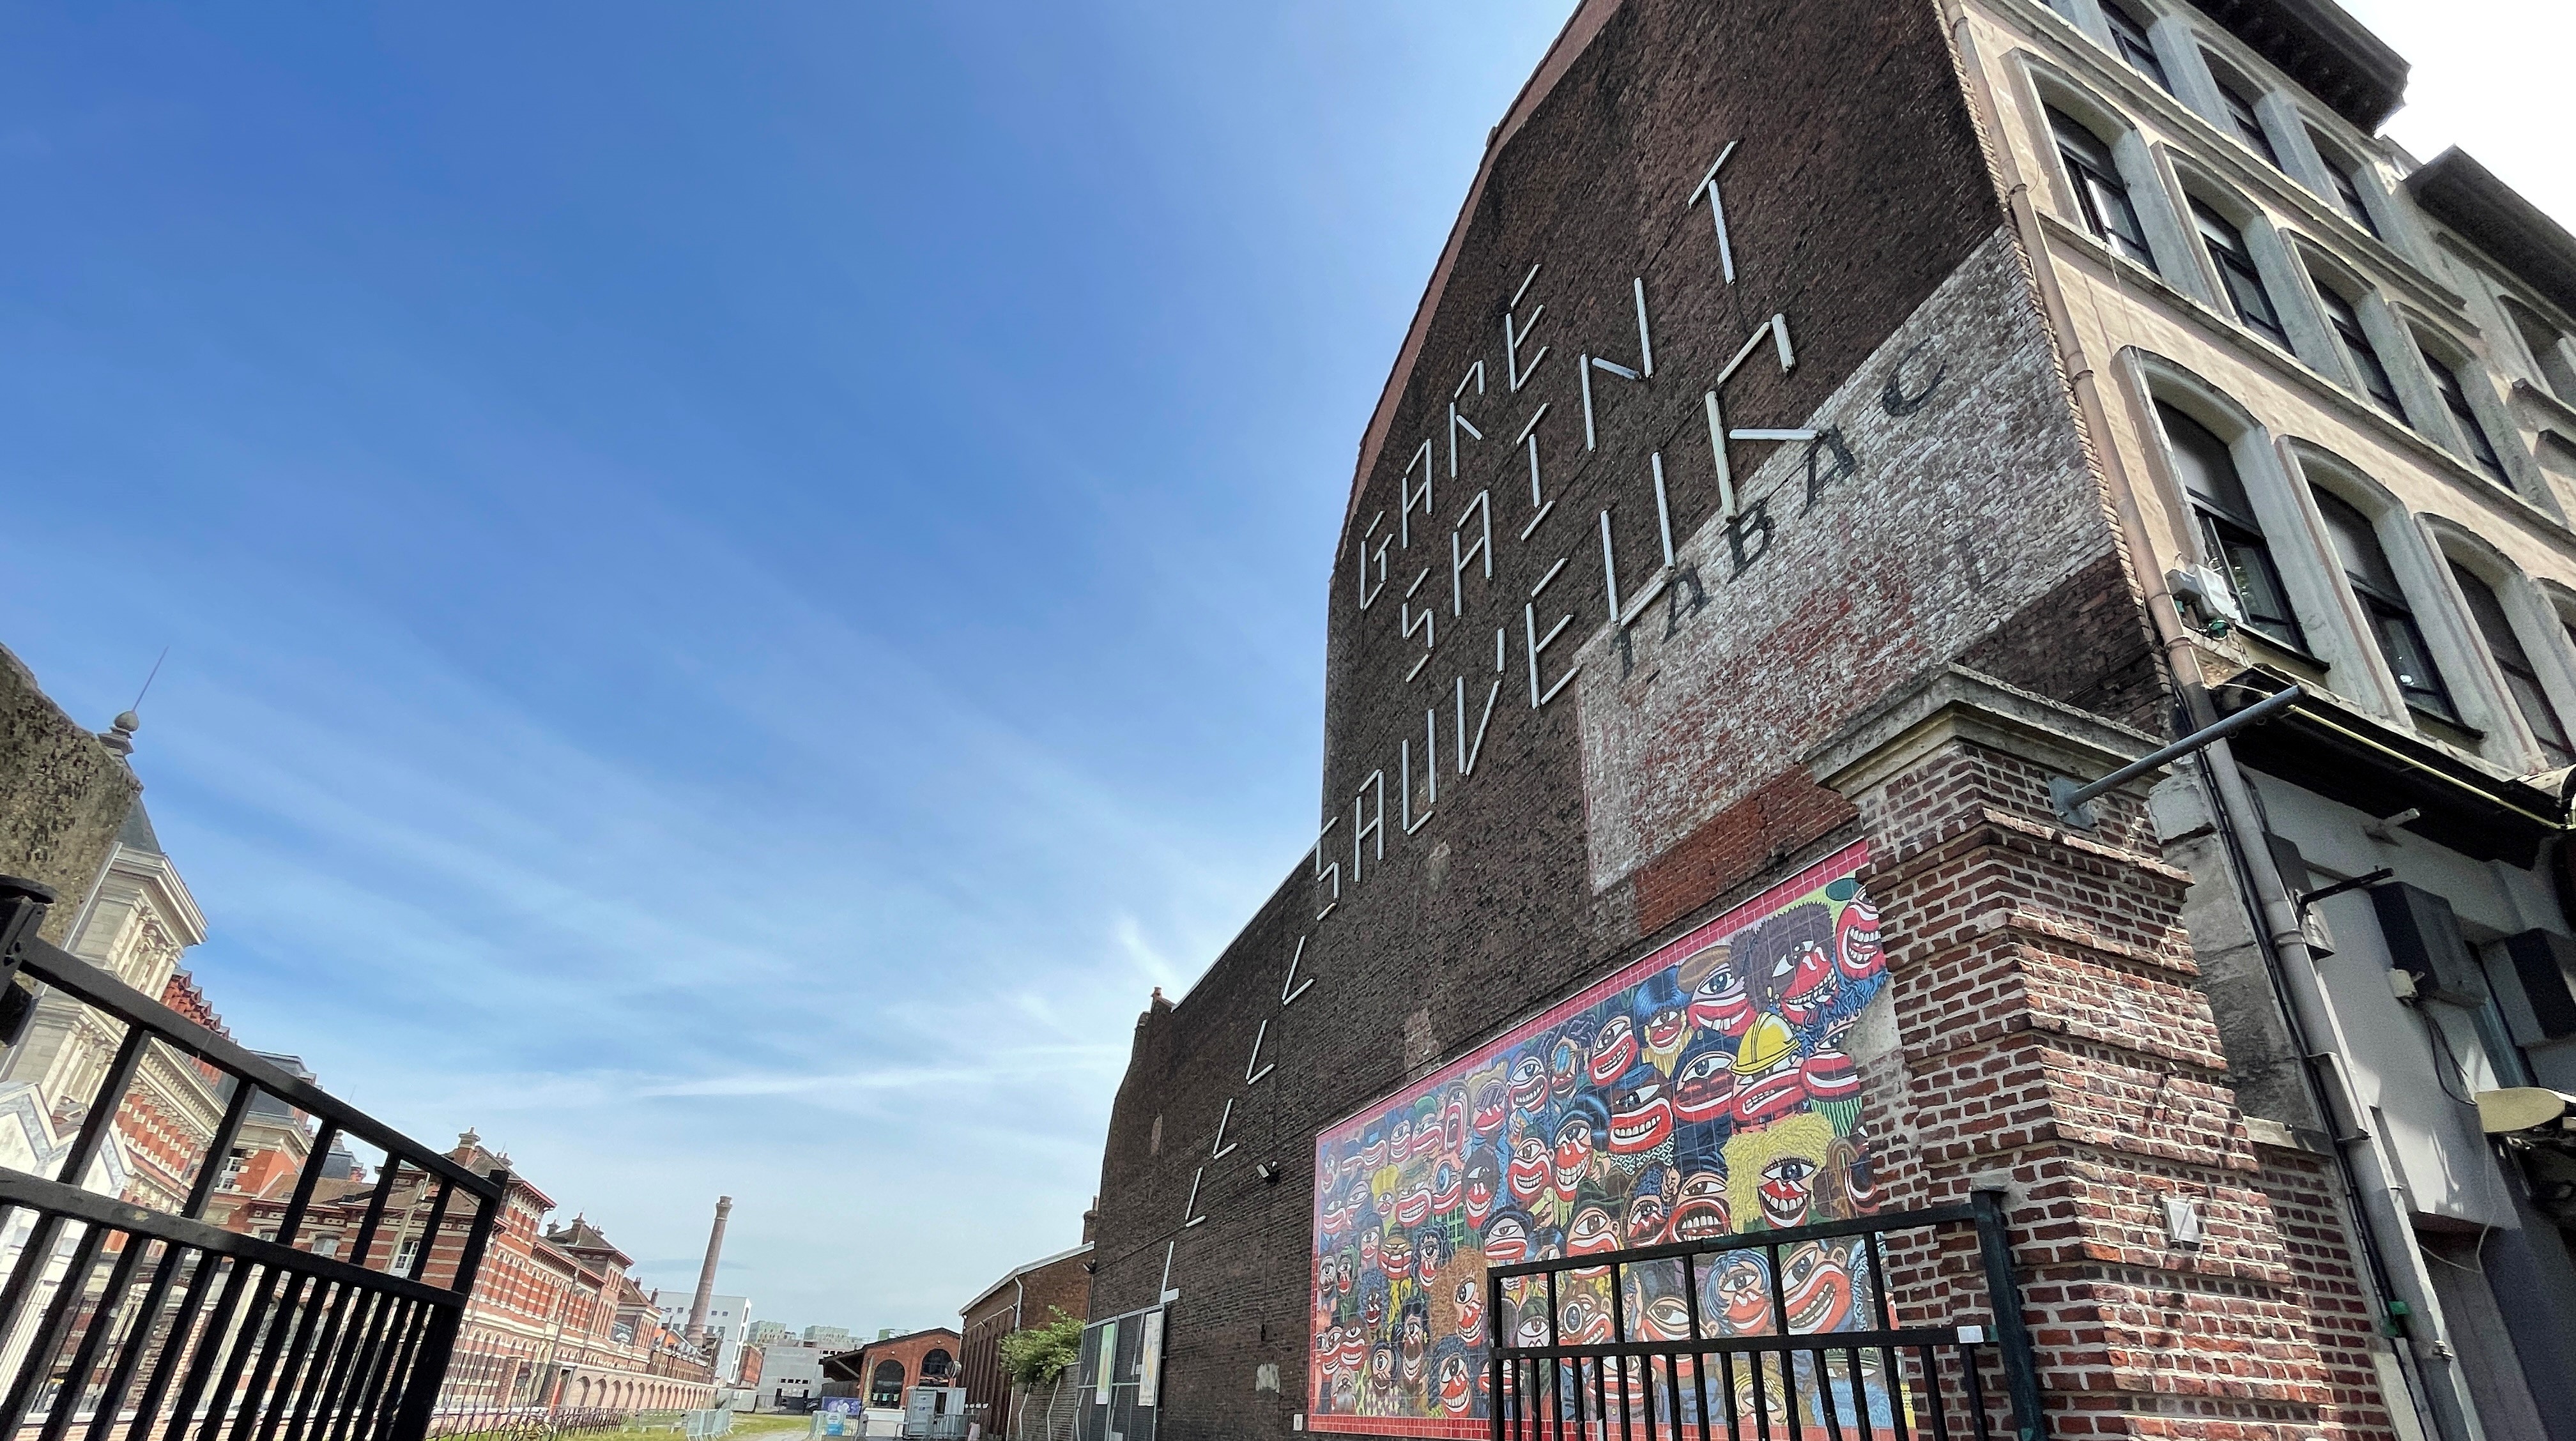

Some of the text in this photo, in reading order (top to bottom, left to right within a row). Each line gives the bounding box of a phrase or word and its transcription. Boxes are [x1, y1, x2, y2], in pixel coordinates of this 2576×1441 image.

[1315, 312, 1822, 921] SAUVEUR
[1359, 263, 1549, 611] GARE
[1402, 139, 1738, 682] SAINT
[1608, 339, 1947, 683] TABAC
